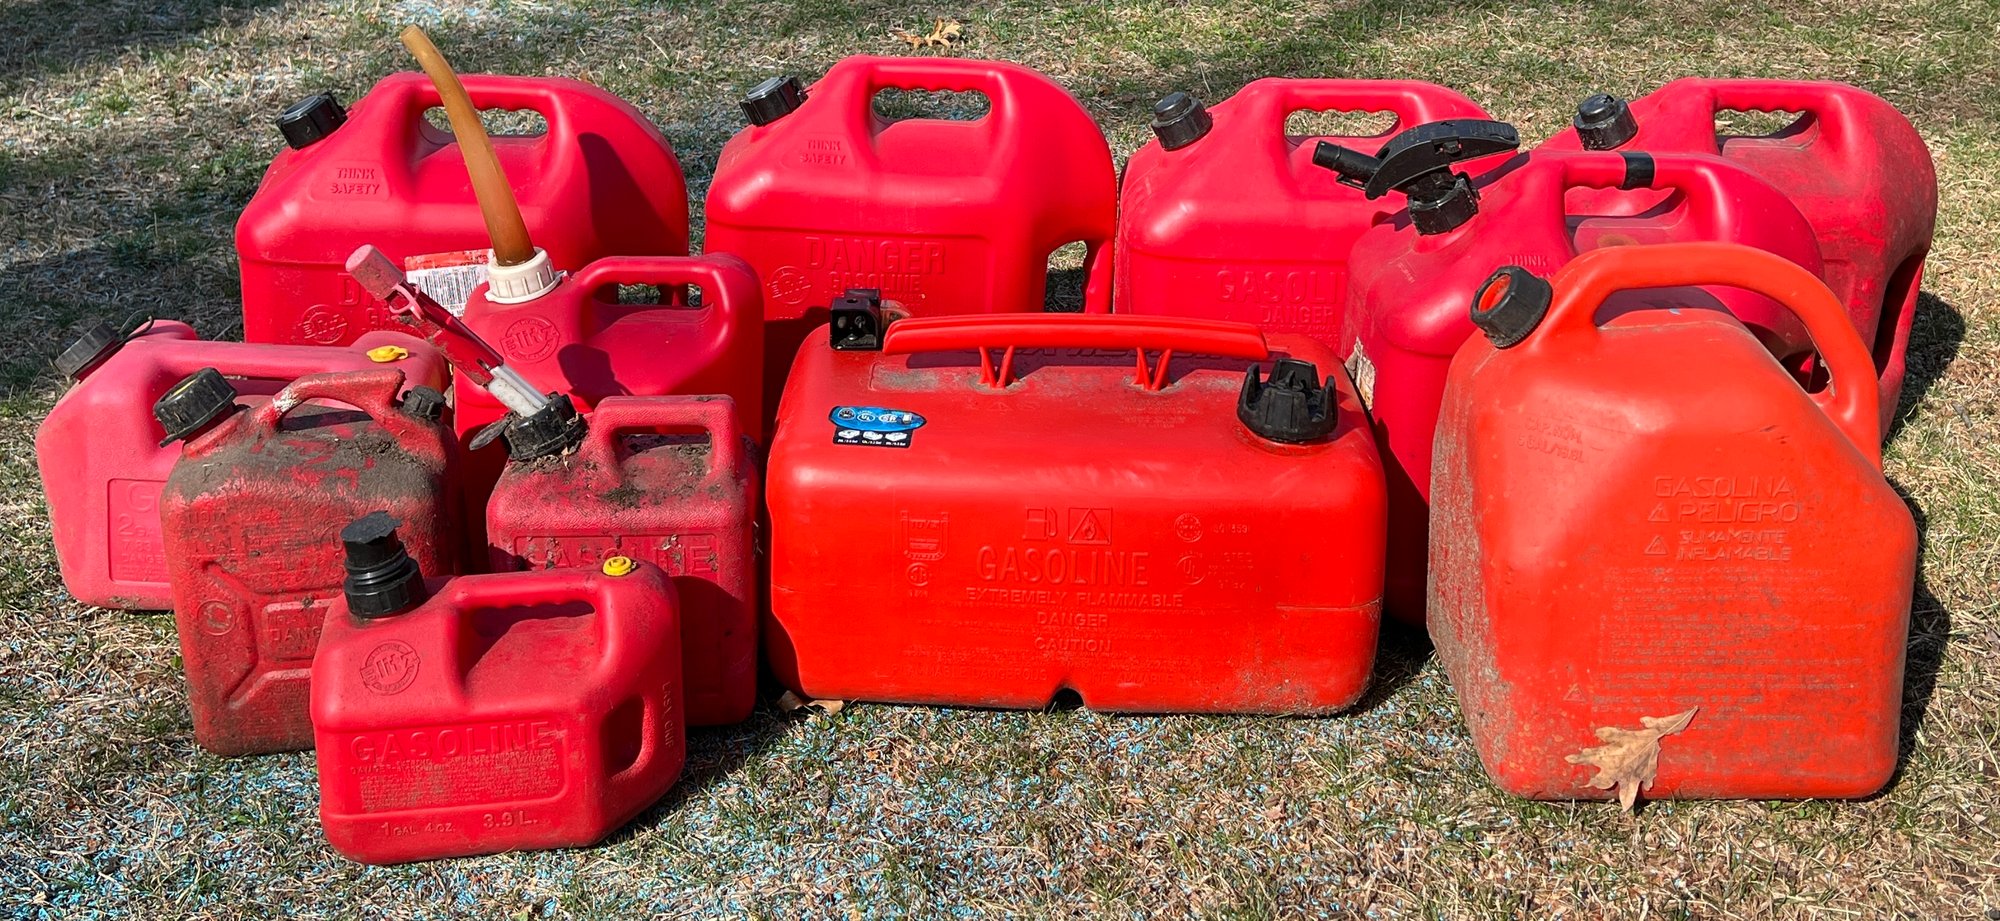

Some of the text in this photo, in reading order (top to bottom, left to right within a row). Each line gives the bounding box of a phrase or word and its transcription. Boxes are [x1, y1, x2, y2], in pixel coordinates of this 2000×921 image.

[808, 139, 841, 151] THINK
[800, 151, 846, 165] SAFETY
[336, 167, 375, 180] THINK
[329, 182, 380, 195] SAFETY
[804, 236, 946, 275] DANGER
[1260, 304, 1338, 324] DANGER
[1654, 475, 1794, 498] GASOLINA
[1677, 501, 1801, 524] PELIGRO
[1678, 529, 1788, 545] SUMAMENTE
[1678, 545, 1793, 562] INFLAMABLE
[976, 546, 1152, 587] GASOLINE
[966, 586, 1185, 608] EXTREMELY FLAMMABLE
[1036, 611, 1110, 627] DANGER
[1034, 636, 1113, 653] CAUTION
[350, 721, 550, 763] GASOLINE
[482, 811, 514, 830] 3.9
